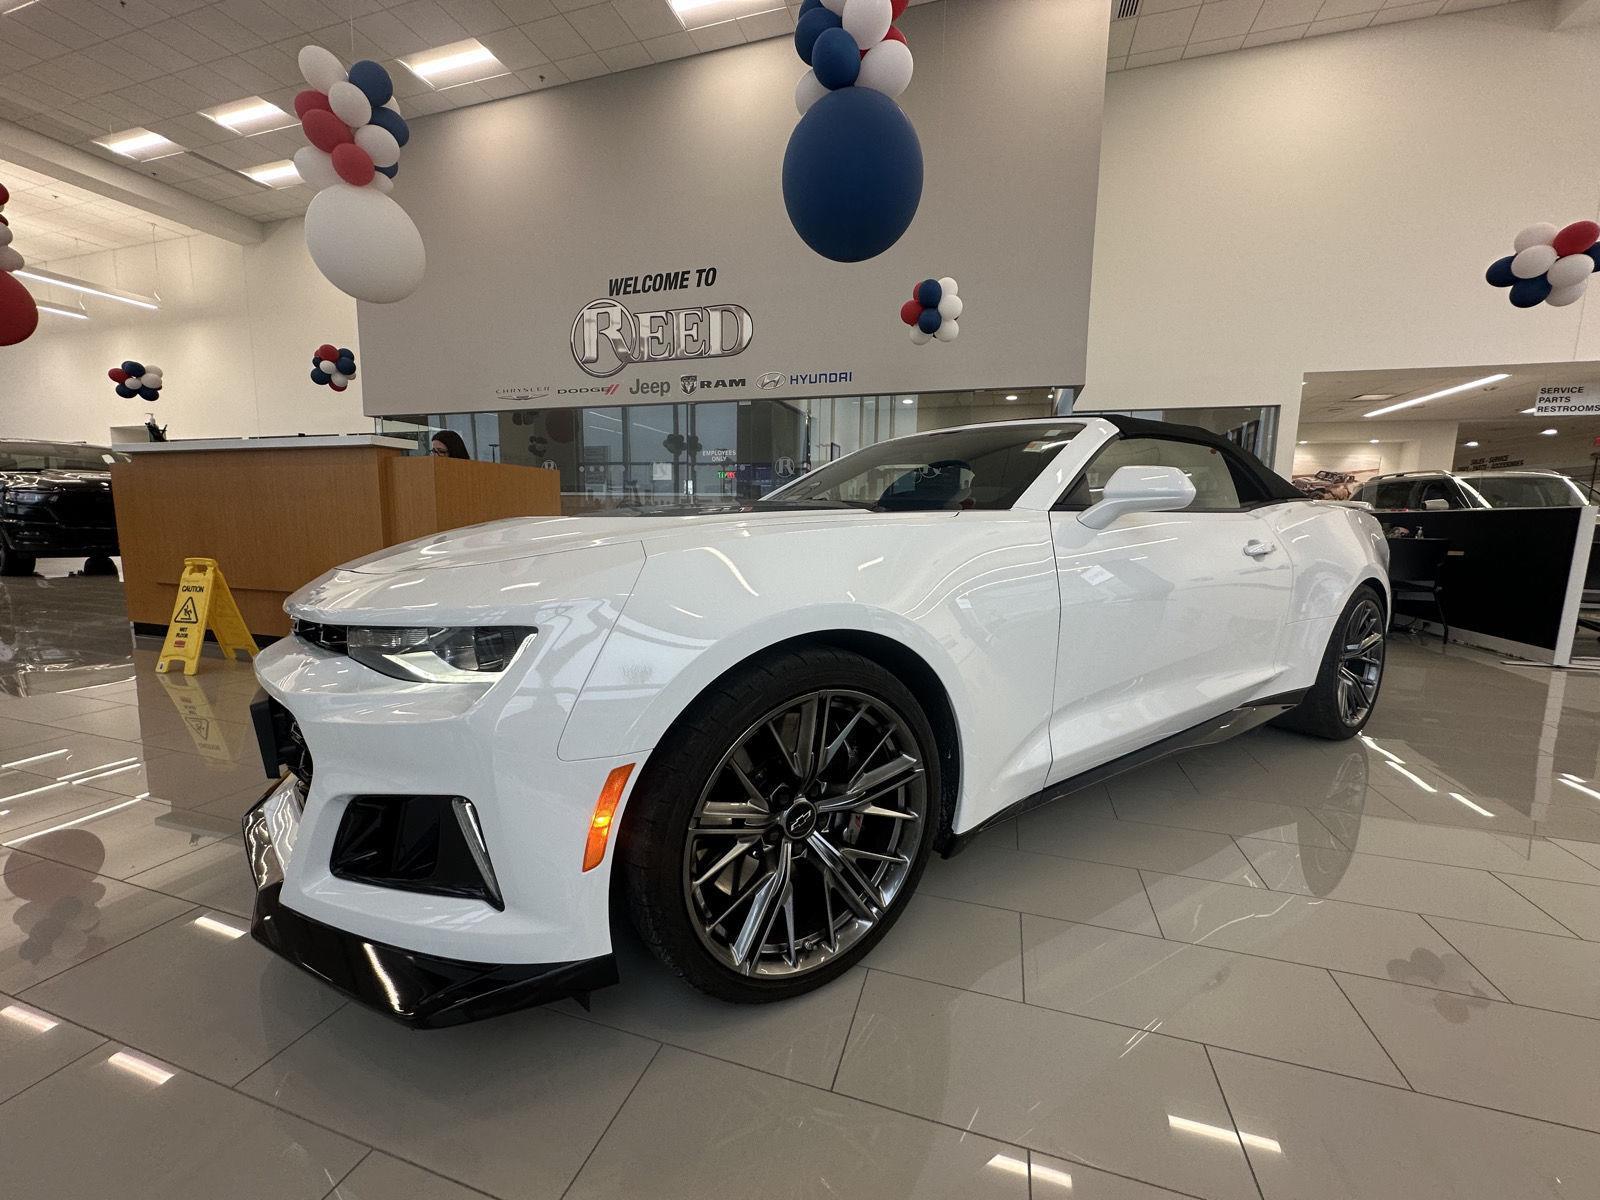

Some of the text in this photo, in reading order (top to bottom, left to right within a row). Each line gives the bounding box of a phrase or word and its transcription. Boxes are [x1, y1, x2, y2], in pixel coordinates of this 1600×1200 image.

[609, 267, 717, 297] WELCOME TO
[570, 298, 753, 378] REED
[700, 378, 746, 389] RAM
[790, 371, 852, 385] HYUNDAI
[495, 386, 550, 394] CHRYSLER
[557, 386, 609, 395] DODGE
[629, 378, 671, 397] Jeep
[1540, 386, 1584, 394] SERVICE
[1537, 404, 1600, 412] RESTROOMS
[776, 457, 795, 477] R
